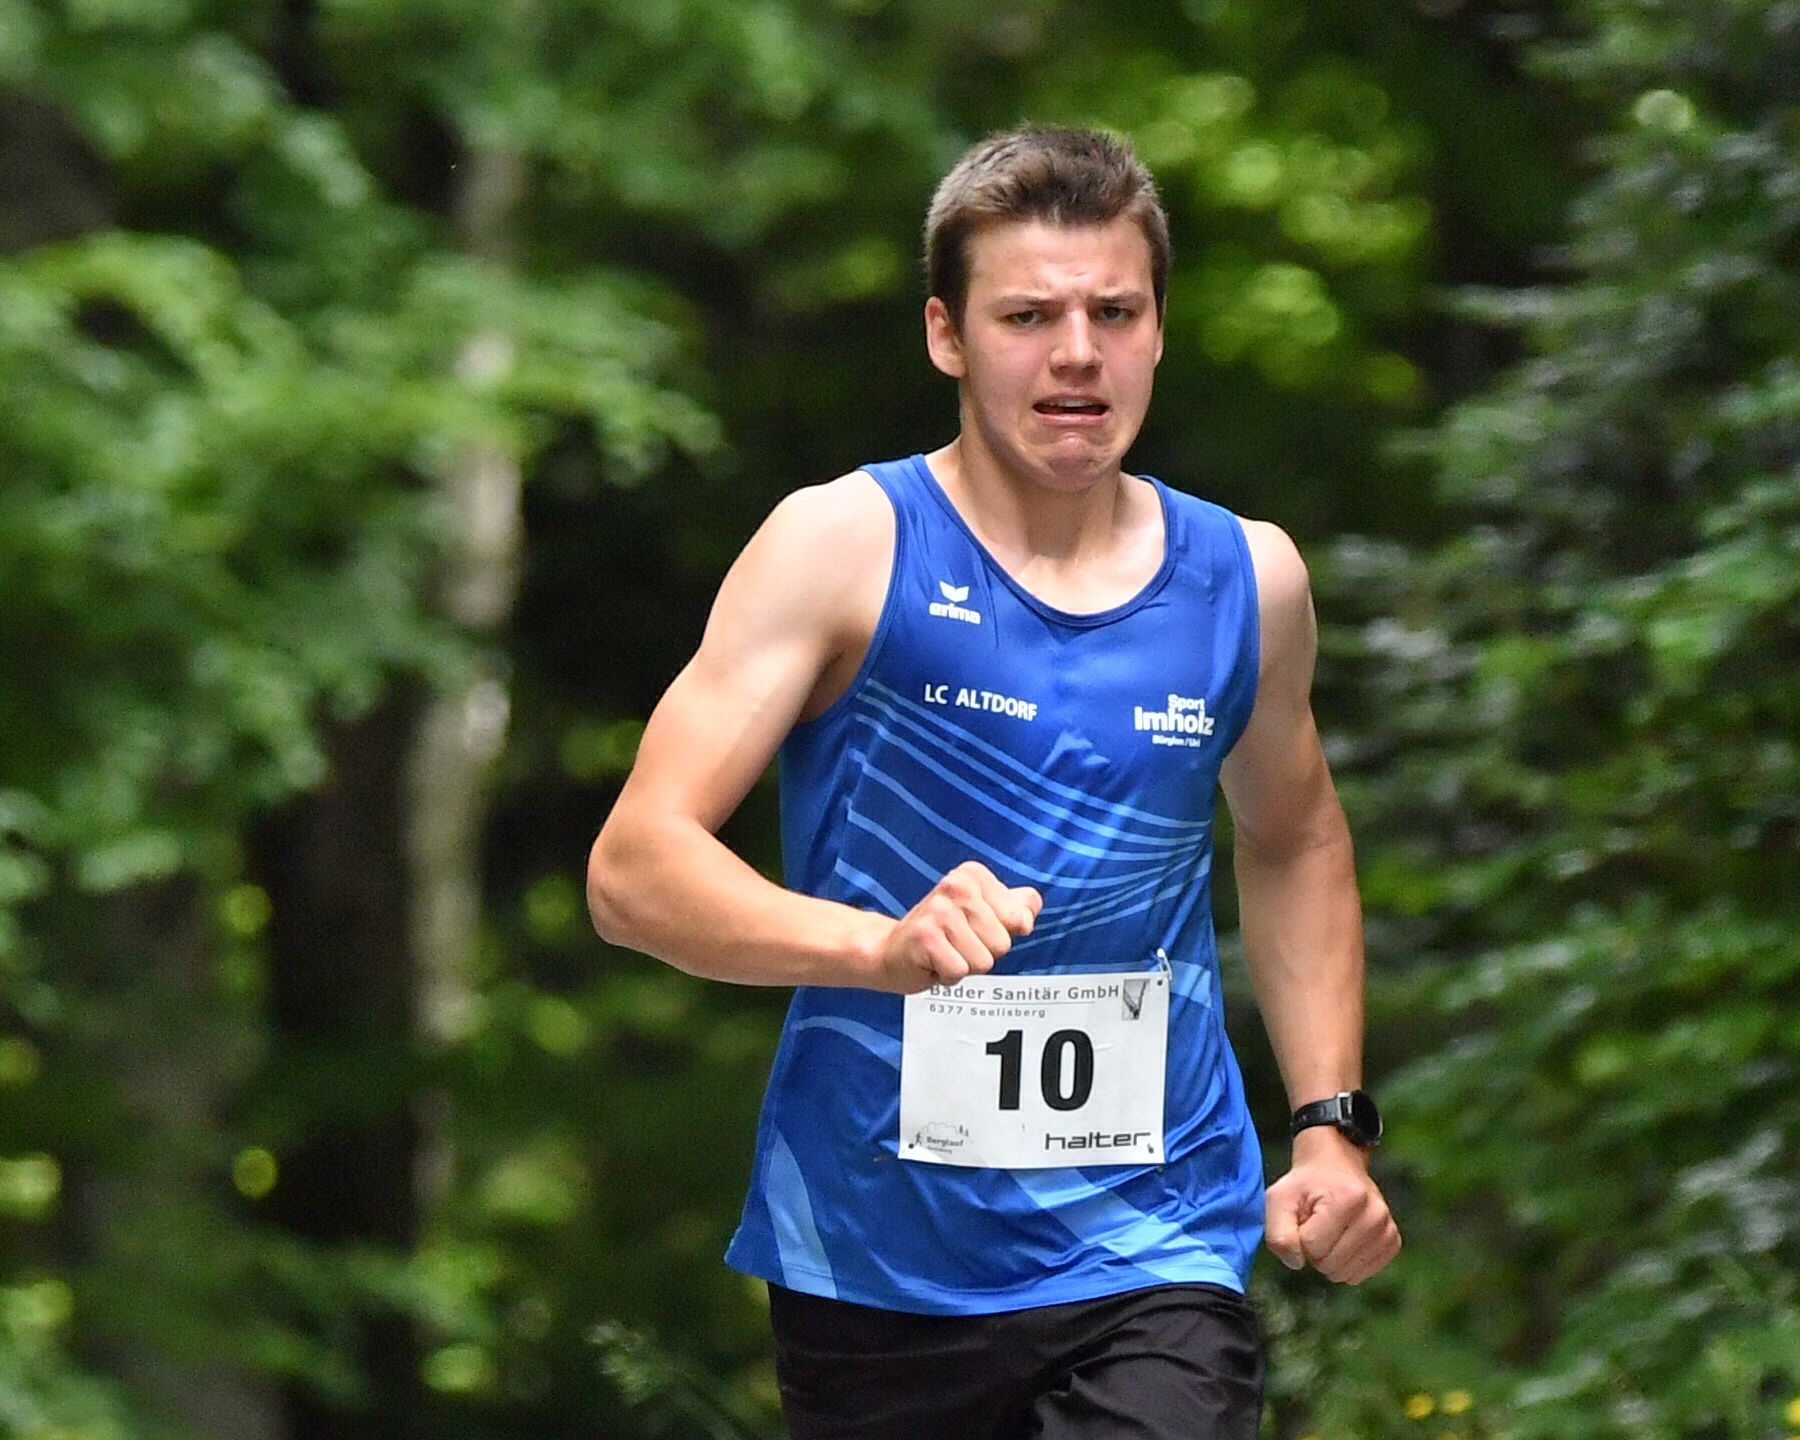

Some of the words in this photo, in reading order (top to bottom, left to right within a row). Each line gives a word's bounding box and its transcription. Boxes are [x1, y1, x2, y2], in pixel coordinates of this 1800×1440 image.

[929, 602, 981, 625] erima
[924, 683, 949, 704] LC
[955, 688, 1038, 721] ALTDORF
[1167, 693, 1205, 712] Sport
[1134, 705, 1215, 736] Imholz
[993, 986, 1060, 1001] Sanitär
[1067, 985, 1119, 999] GmbH
[929, 1004, 963, 1015] 6377
[970, 1005, 1046, 1018] Seelisberg
[985, 1029, 1095, 1111] 10
[1045, 1132, 1151, 1150] halter
